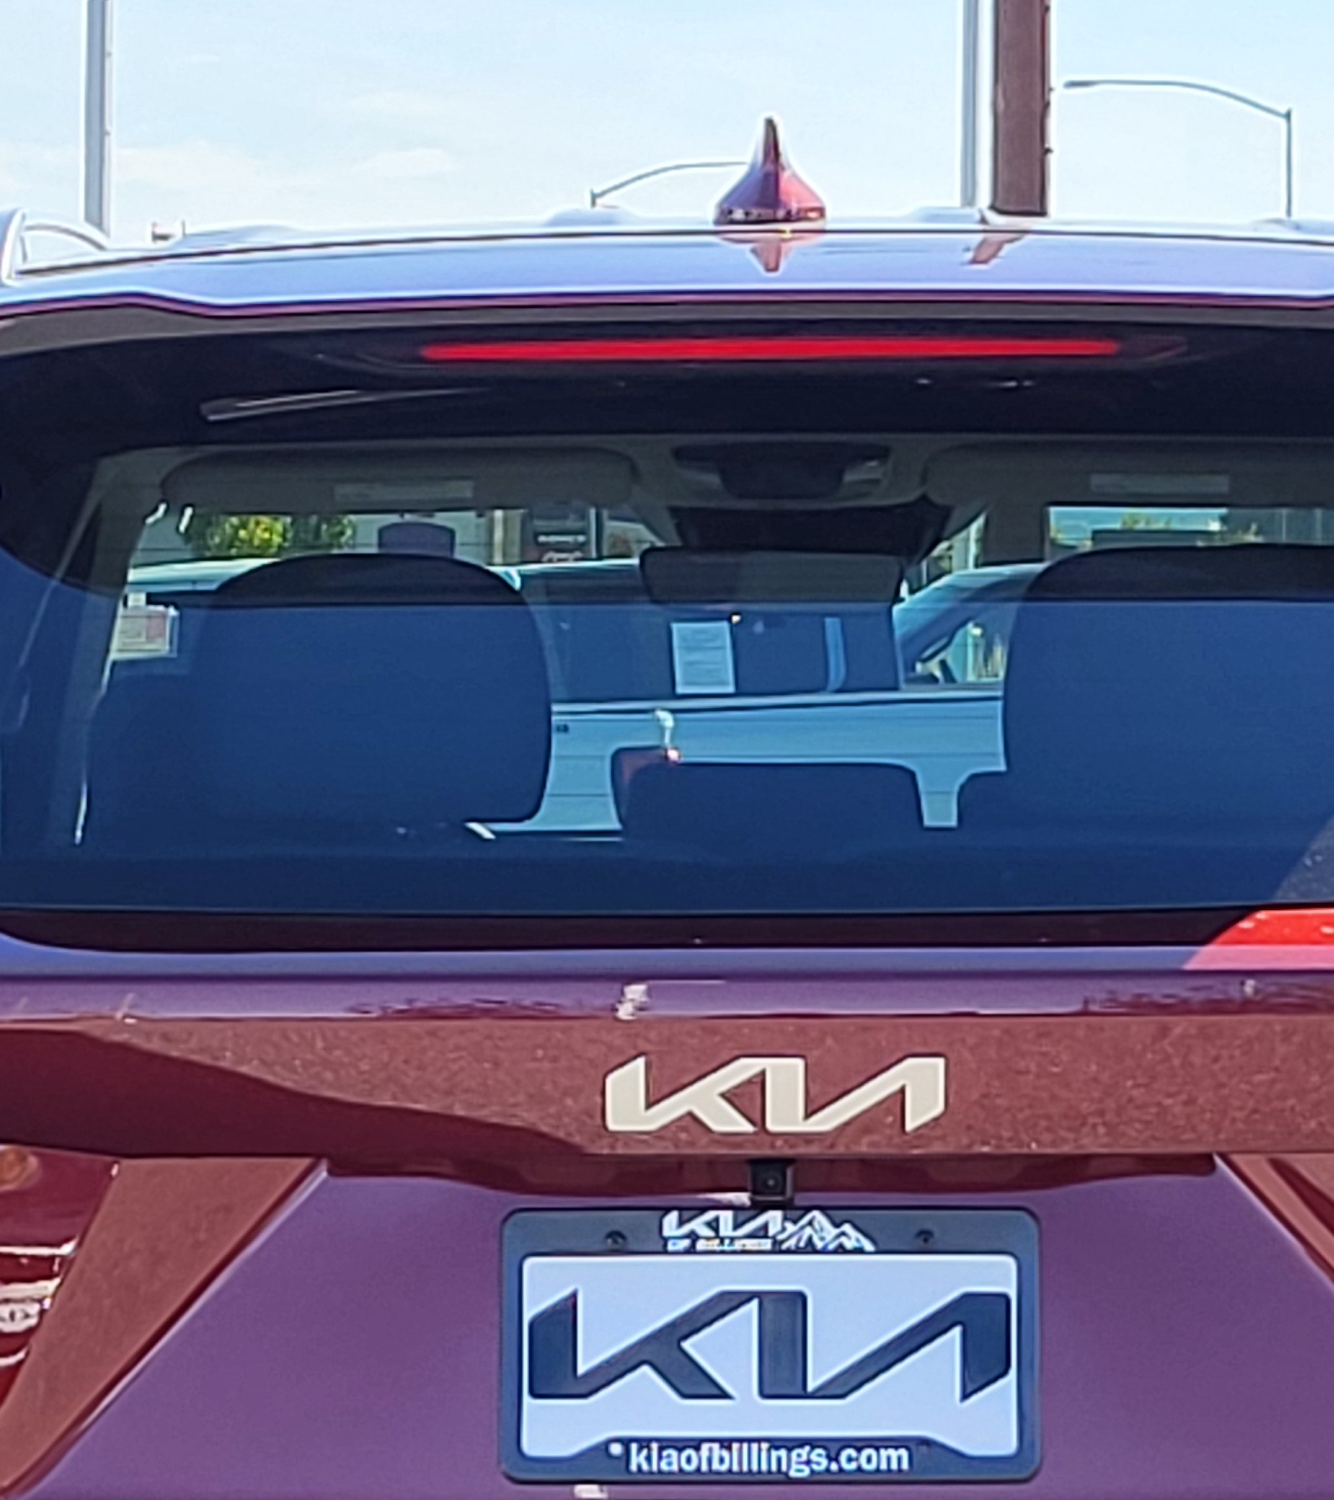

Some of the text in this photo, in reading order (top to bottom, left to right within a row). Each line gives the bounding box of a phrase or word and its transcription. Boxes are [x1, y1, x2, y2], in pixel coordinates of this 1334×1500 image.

[605, 1055, 947, 1134] KIA
[662, 1210, 783, 1237] KIA
[527, 1288, 1013, 1404] KIA
[628, 1441, 910, 1477] kiaofbillings.com
